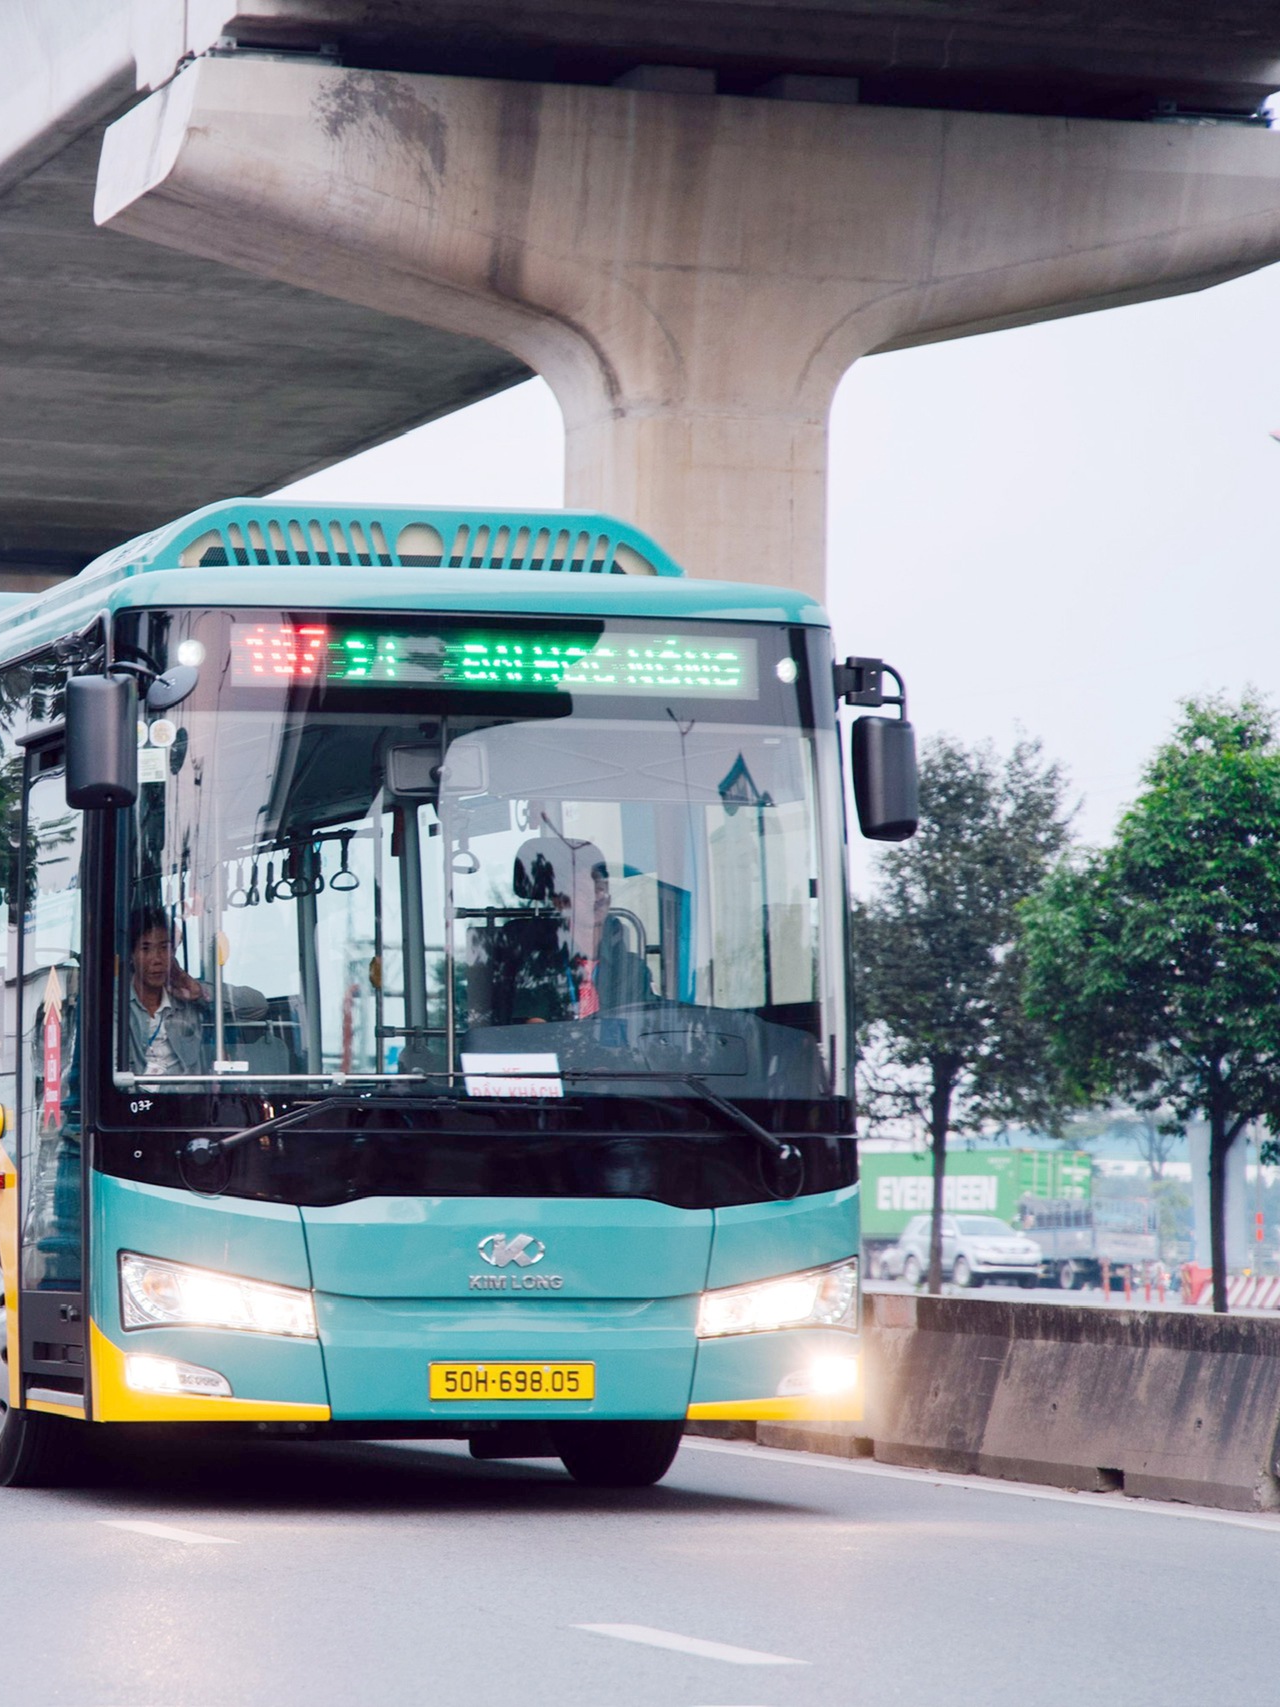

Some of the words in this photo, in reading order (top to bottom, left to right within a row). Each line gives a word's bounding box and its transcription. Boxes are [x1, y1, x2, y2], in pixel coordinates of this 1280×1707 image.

[877, 1176, 997, 1211] EVERREEN
[469, 1275, 507, 1291] KIM
[511, 1275, 564, 1291] LONG
